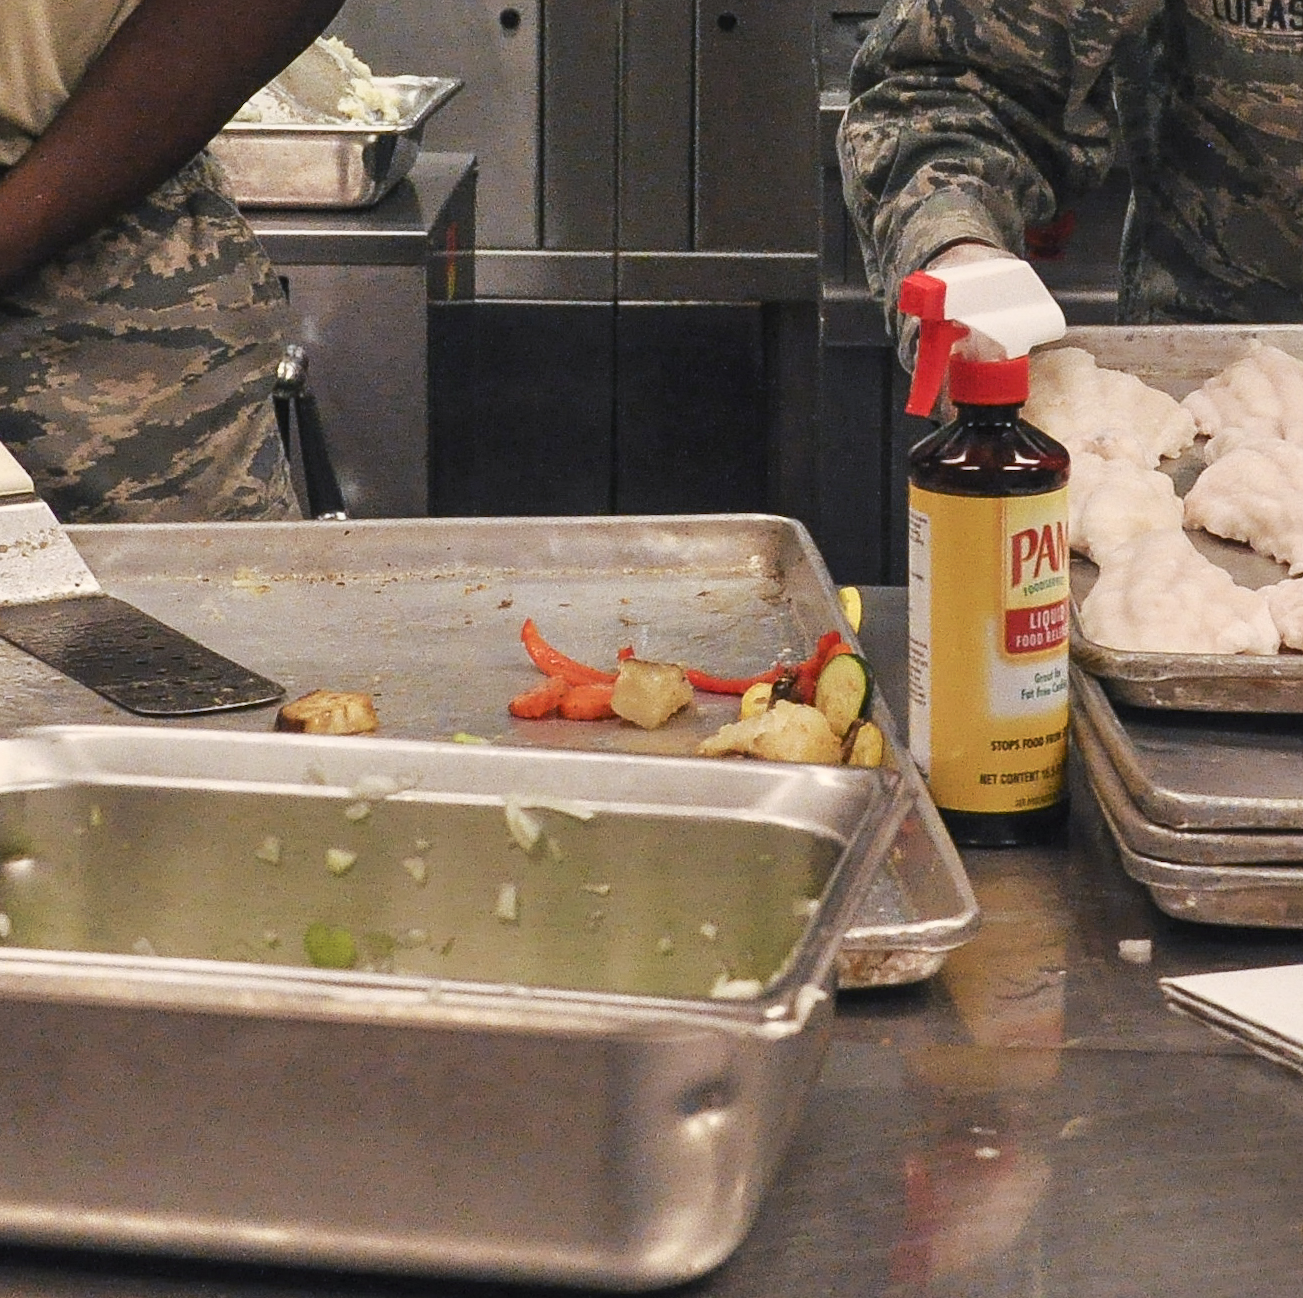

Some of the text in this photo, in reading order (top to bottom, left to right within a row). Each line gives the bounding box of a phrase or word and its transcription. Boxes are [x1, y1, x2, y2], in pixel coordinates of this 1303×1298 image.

[1015, 632, 1044, 649] FOOD
[991, 738, 1020, 752] STOPS
[1022, 735, 1044, 749] FOOD
[979, 772, 998, 786] NET
